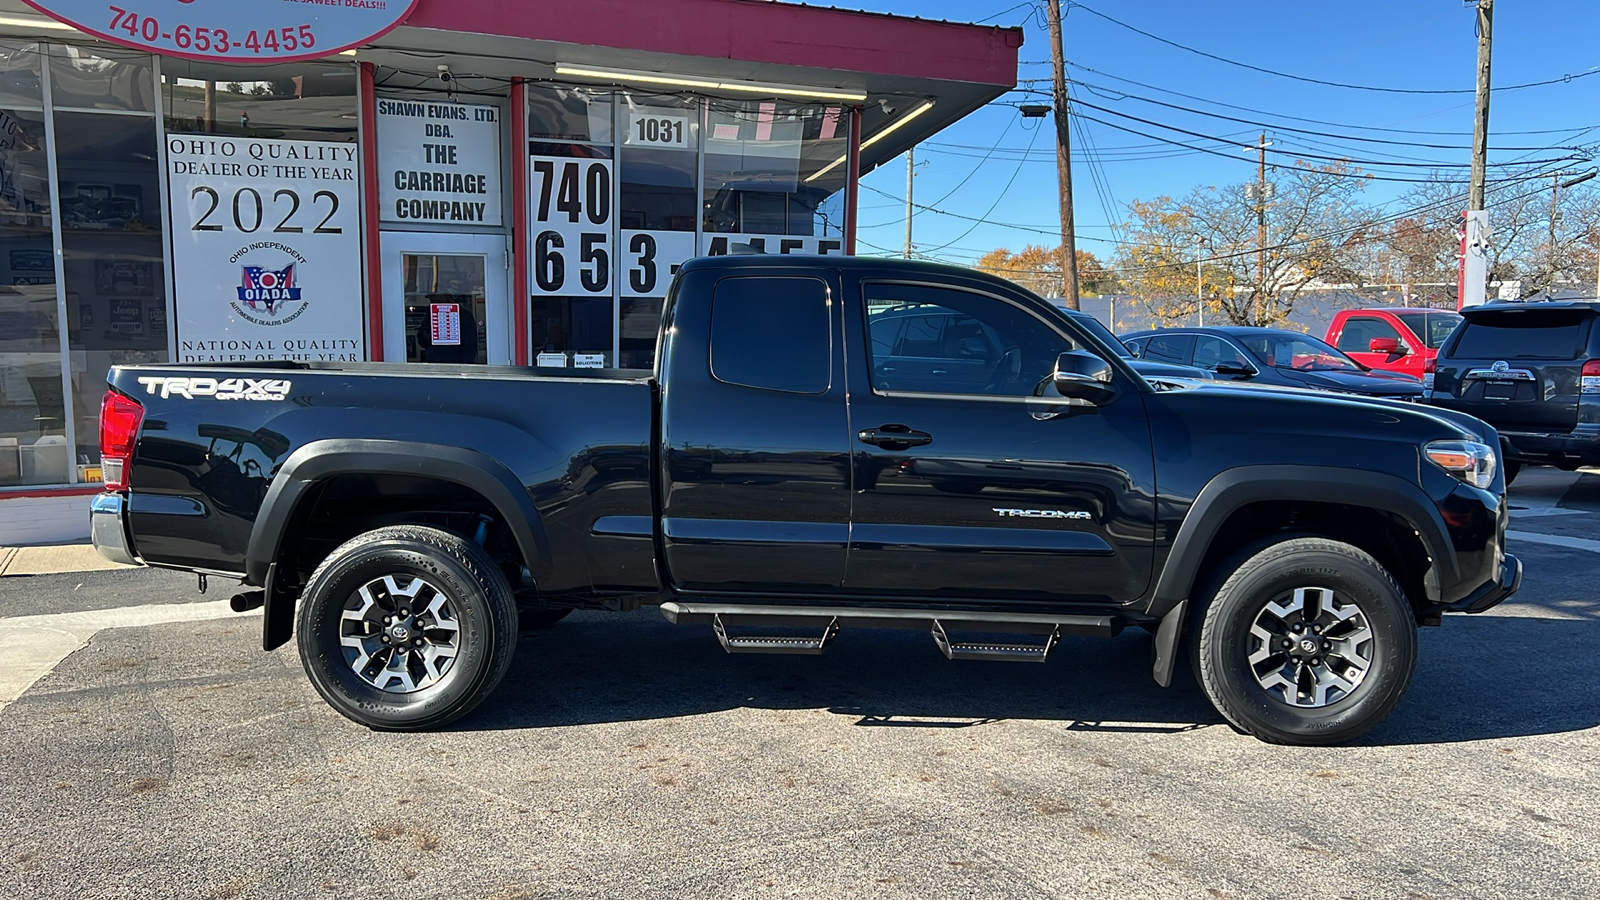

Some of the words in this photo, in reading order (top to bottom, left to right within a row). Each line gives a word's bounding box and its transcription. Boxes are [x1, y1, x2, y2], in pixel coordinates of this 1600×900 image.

[345, 0, 386, 10] DEALS!!!
[109, 5, 316, 54] 740-653-4455
[379, 101, 425, 118] SHAWN
[428, 104, 470, 121] EVANS.
[474, 108, 498, 123] LTD.
[425, 123, 454, 138] DBA.
[635, 118, 682, 143] 1031
[170, 139, 236, 157] OHIO
[249, 143, 356, 162] QUALITY
[423, 143, 458, 165] THE
[174, 161, 242, 176] DEALER
[247, 164, 269, 177] OF
[273, 165, 307, 179] THE
[311, 167, 354, 181] YEAR
[394, 170, 487, 194] CARRIAGE
[534, 160, 610, 225] 740
[191, 185, 343, 235] 2022
[396, 198, 486, 222] COMPANY
[229, 246, 249, 264] OHIO
[249, 241, 307, 264] INDEPENDENT
[245, 288, 291, 300] OIADA
[230, 301, 258, 325] AUTOMOBILE
[258, 319, 282, 327] DEALERS
[283, 300, 310, 324] ASSOCIATION
[182, 340, 276, 351] NATIONAL
[284, 339, 359, 352] QUALITY
[138, 377, 217, 400] TRD
[992, 507, 1092, 520] TACOMA
